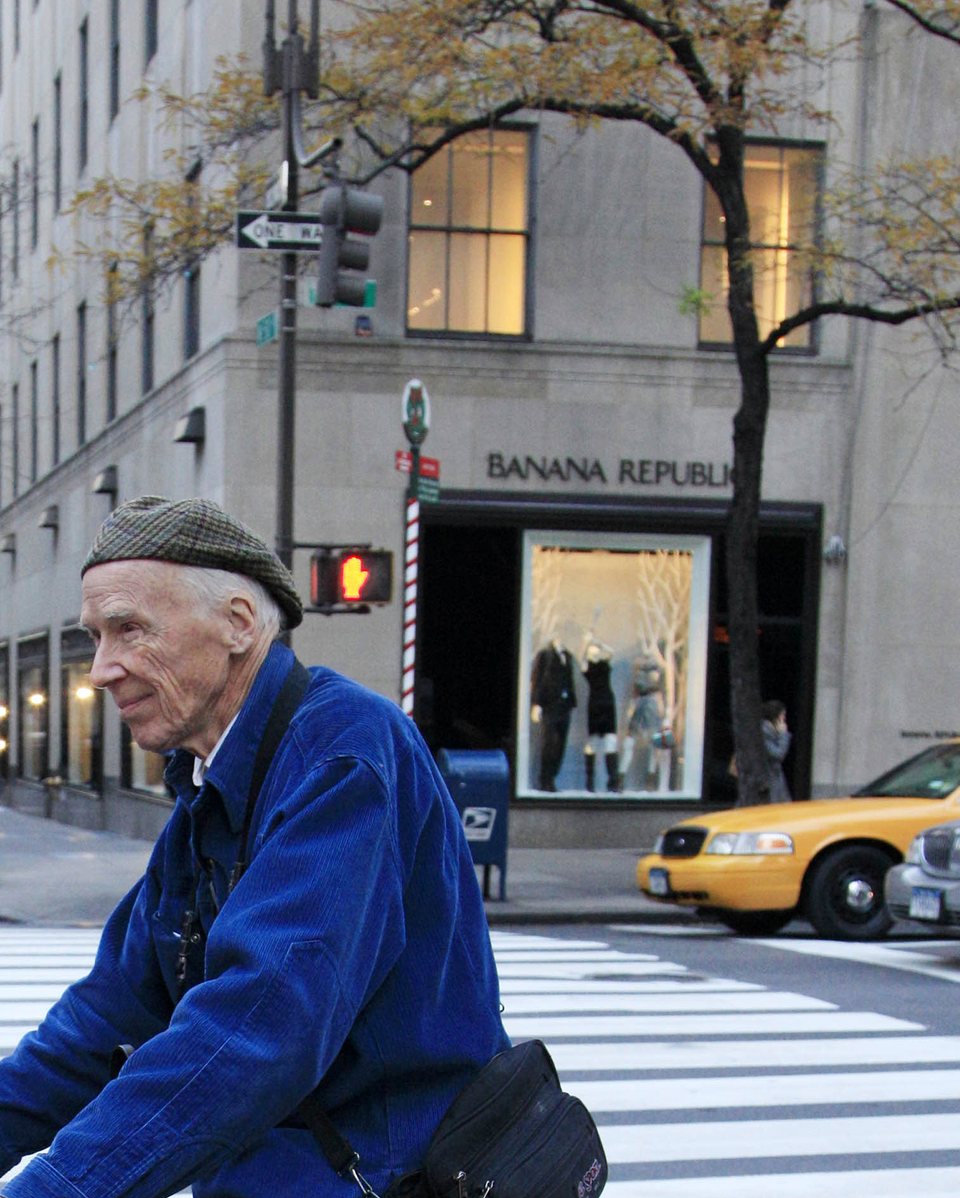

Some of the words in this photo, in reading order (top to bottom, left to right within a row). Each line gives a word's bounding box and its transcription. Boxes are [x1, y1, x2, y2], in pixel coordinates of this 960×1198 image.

[253, 221, 284, 238] ONE
[301, 224, 323, 238] WA
[487, 453, 606, 484] BANANA
[619, 459, 737, 486] REPUBLI
